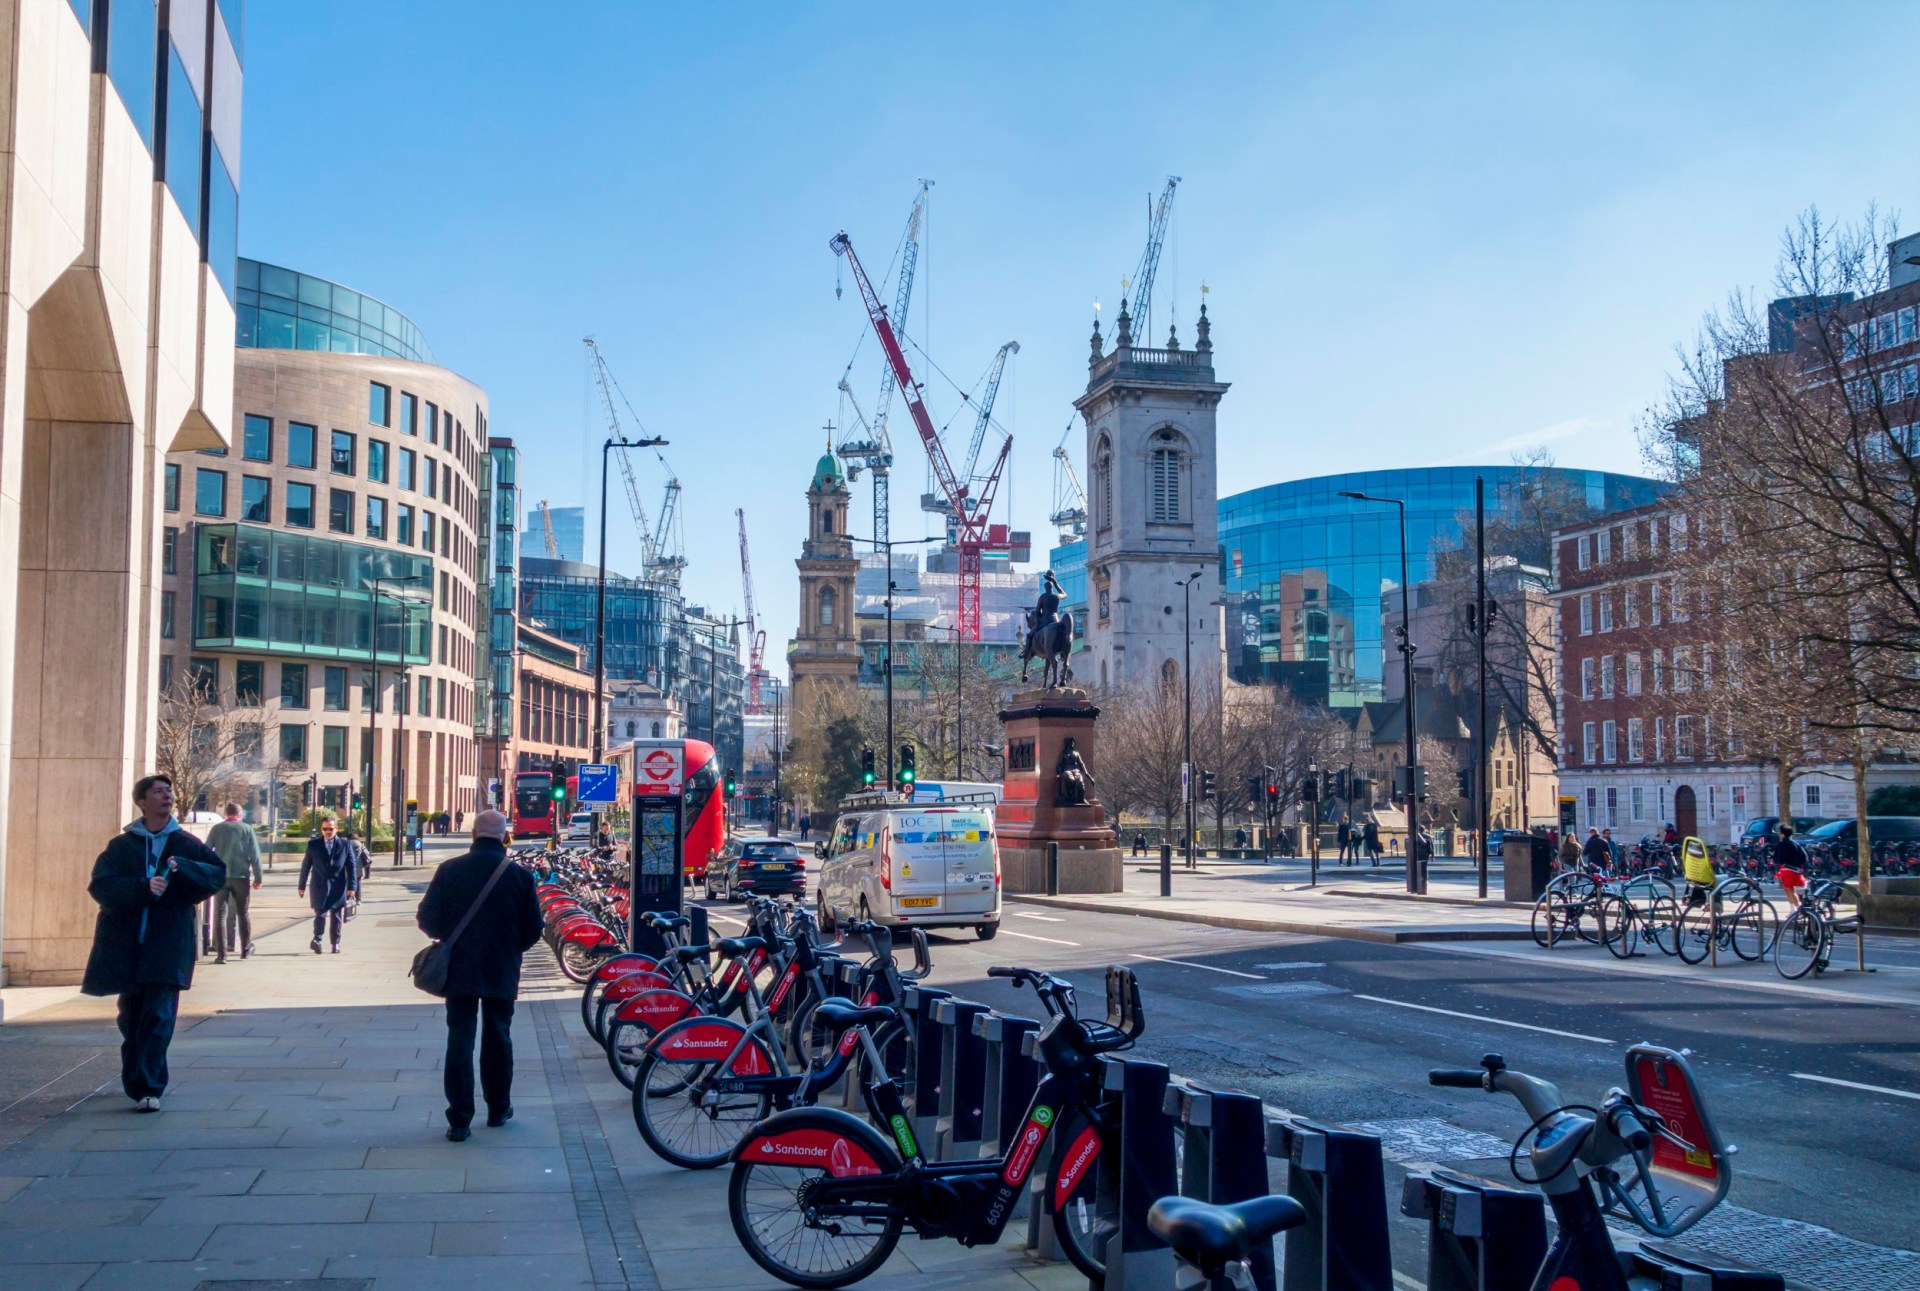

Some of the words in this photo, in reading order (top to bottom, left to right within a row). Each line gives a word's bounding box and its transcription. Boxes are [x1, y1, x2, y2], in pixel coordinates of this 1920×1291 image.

[900, 816, 926, 828] IOC
[643, 1004, 680, 1013] Santander
[683, 1038, 728, 1048] Santander
[775, 1144, 828, 1157] Santander
[897, 1127, 914, 1155] Electric
[1015, 1145, 1030, 1171] Santander
[1066, 1139, 1096, 1179] Santander
[986, 1187, 1012, 1226] 60518
